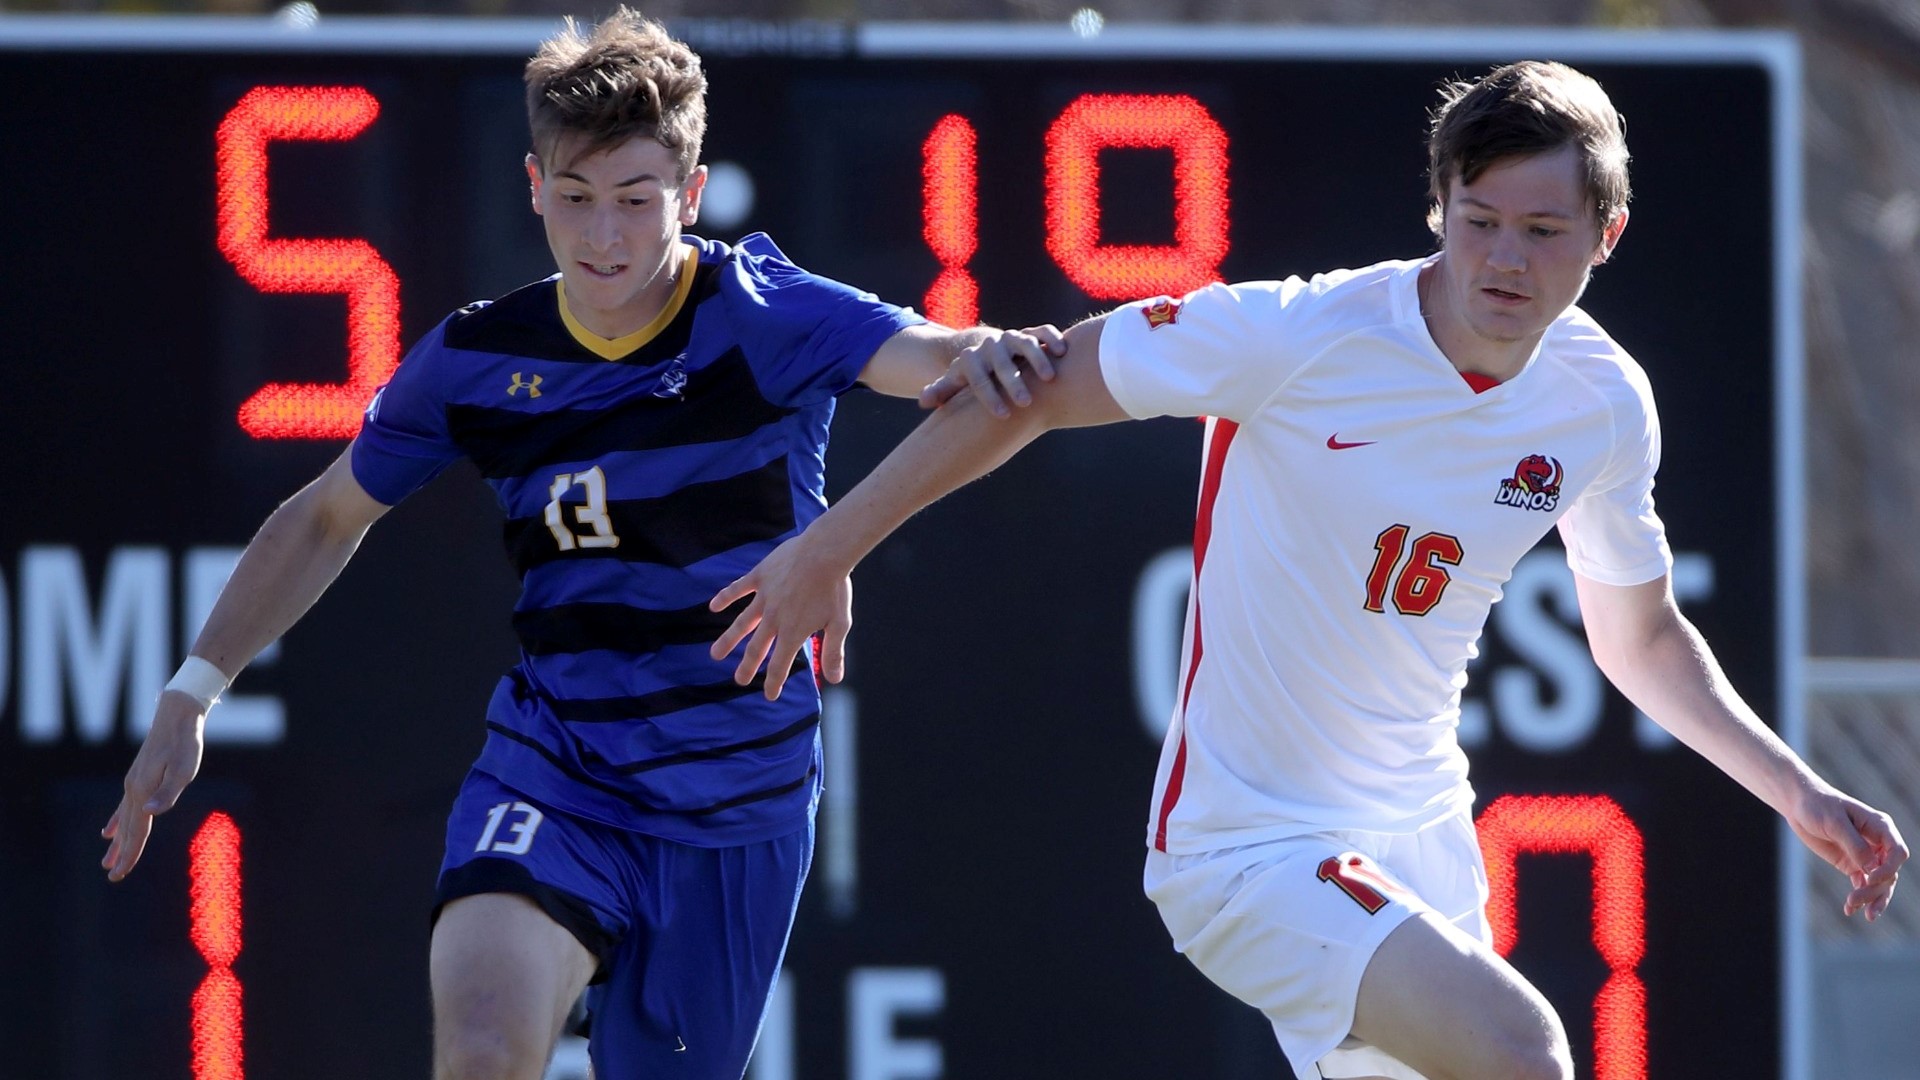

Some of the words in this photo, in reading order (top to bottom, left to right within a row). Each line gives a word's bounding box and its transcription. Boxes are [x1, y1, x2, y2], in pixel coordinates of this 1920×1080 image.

[215, 86, 400, 438] 5
[544, 465, 619, 551] 13
[1494, 485, 1560, 512] DINOS
[1363, 523, 1464, 616] 16
[474, 801, 544, 855] 13
